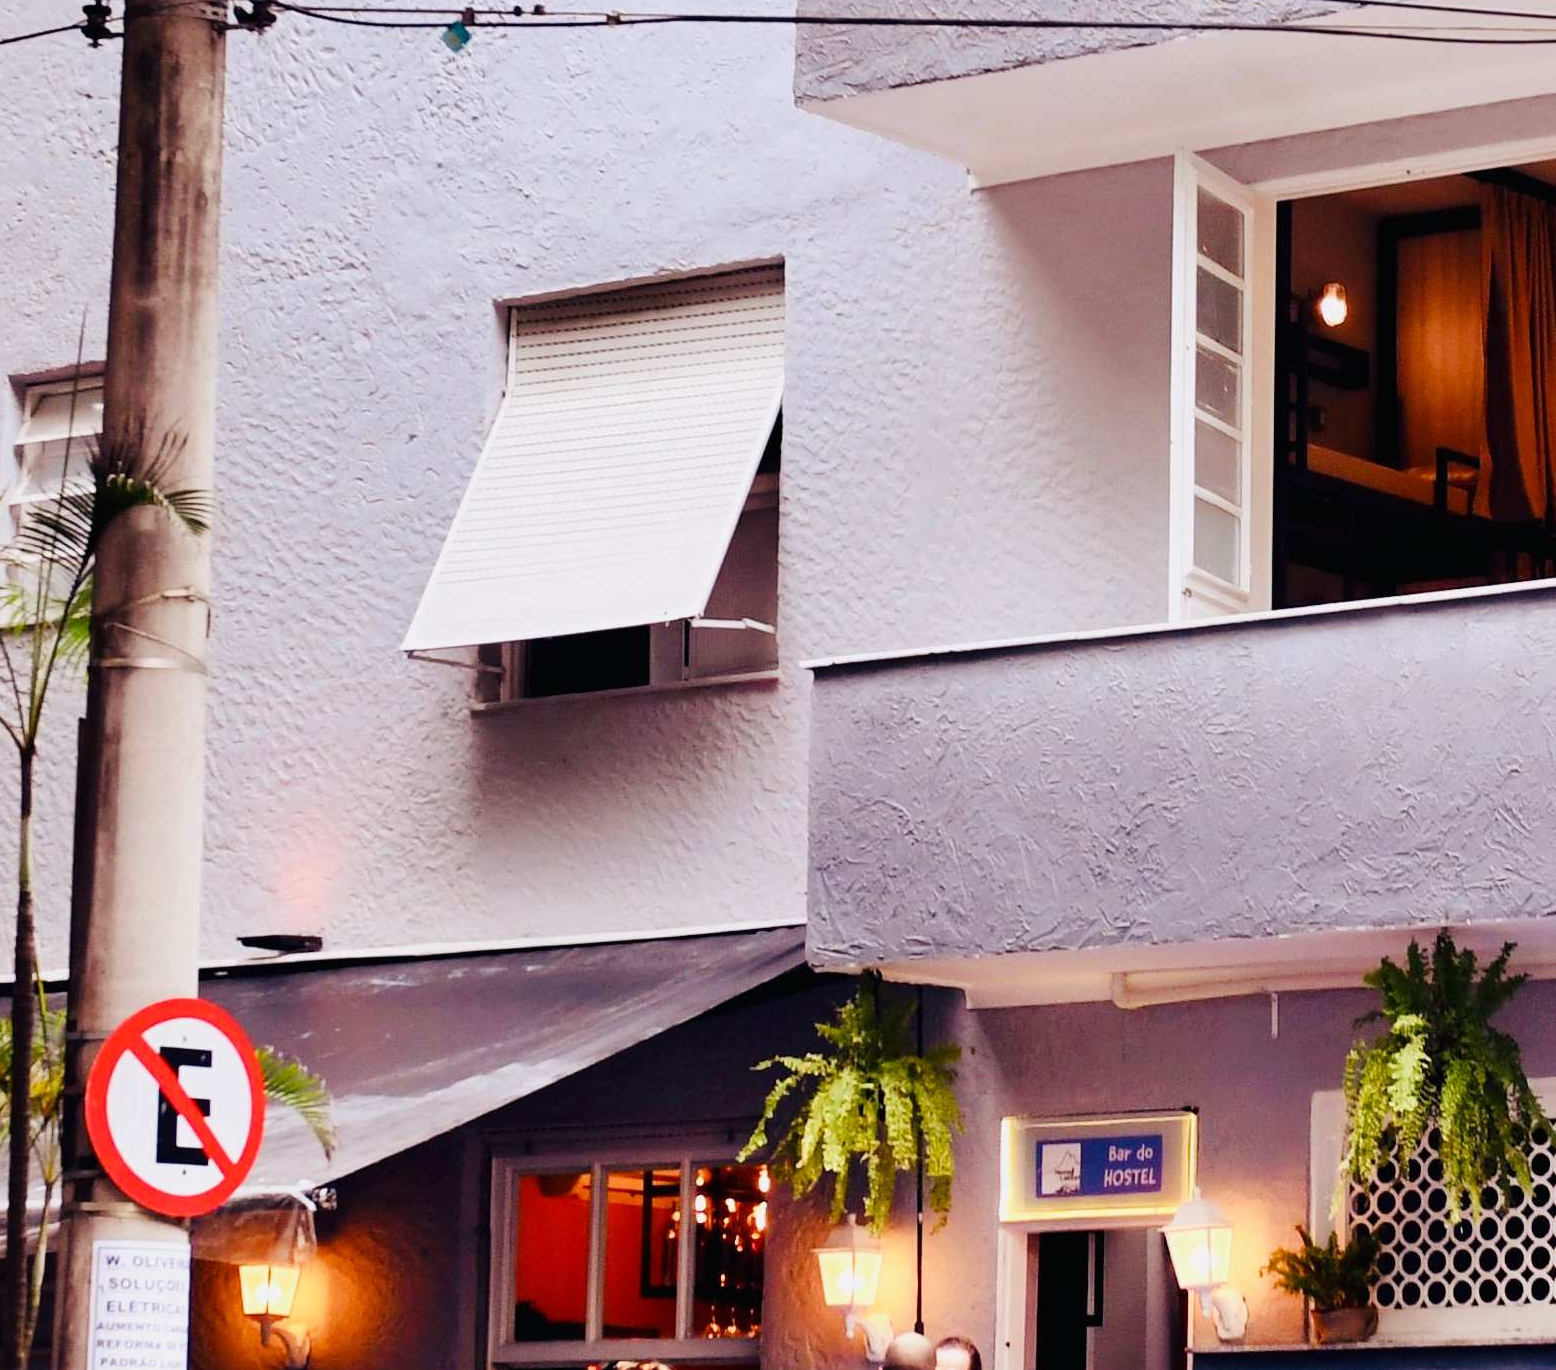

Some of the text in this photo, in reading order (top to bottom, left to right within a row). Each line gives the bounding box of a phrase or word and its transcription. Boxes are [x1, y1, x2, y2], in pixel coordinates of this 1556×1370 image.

[156, 1047, 212, 1166] E
[1109, 1143, 1153, 1162] Bar do
[1104, 1168, 1157, 1188] HOSTEL
